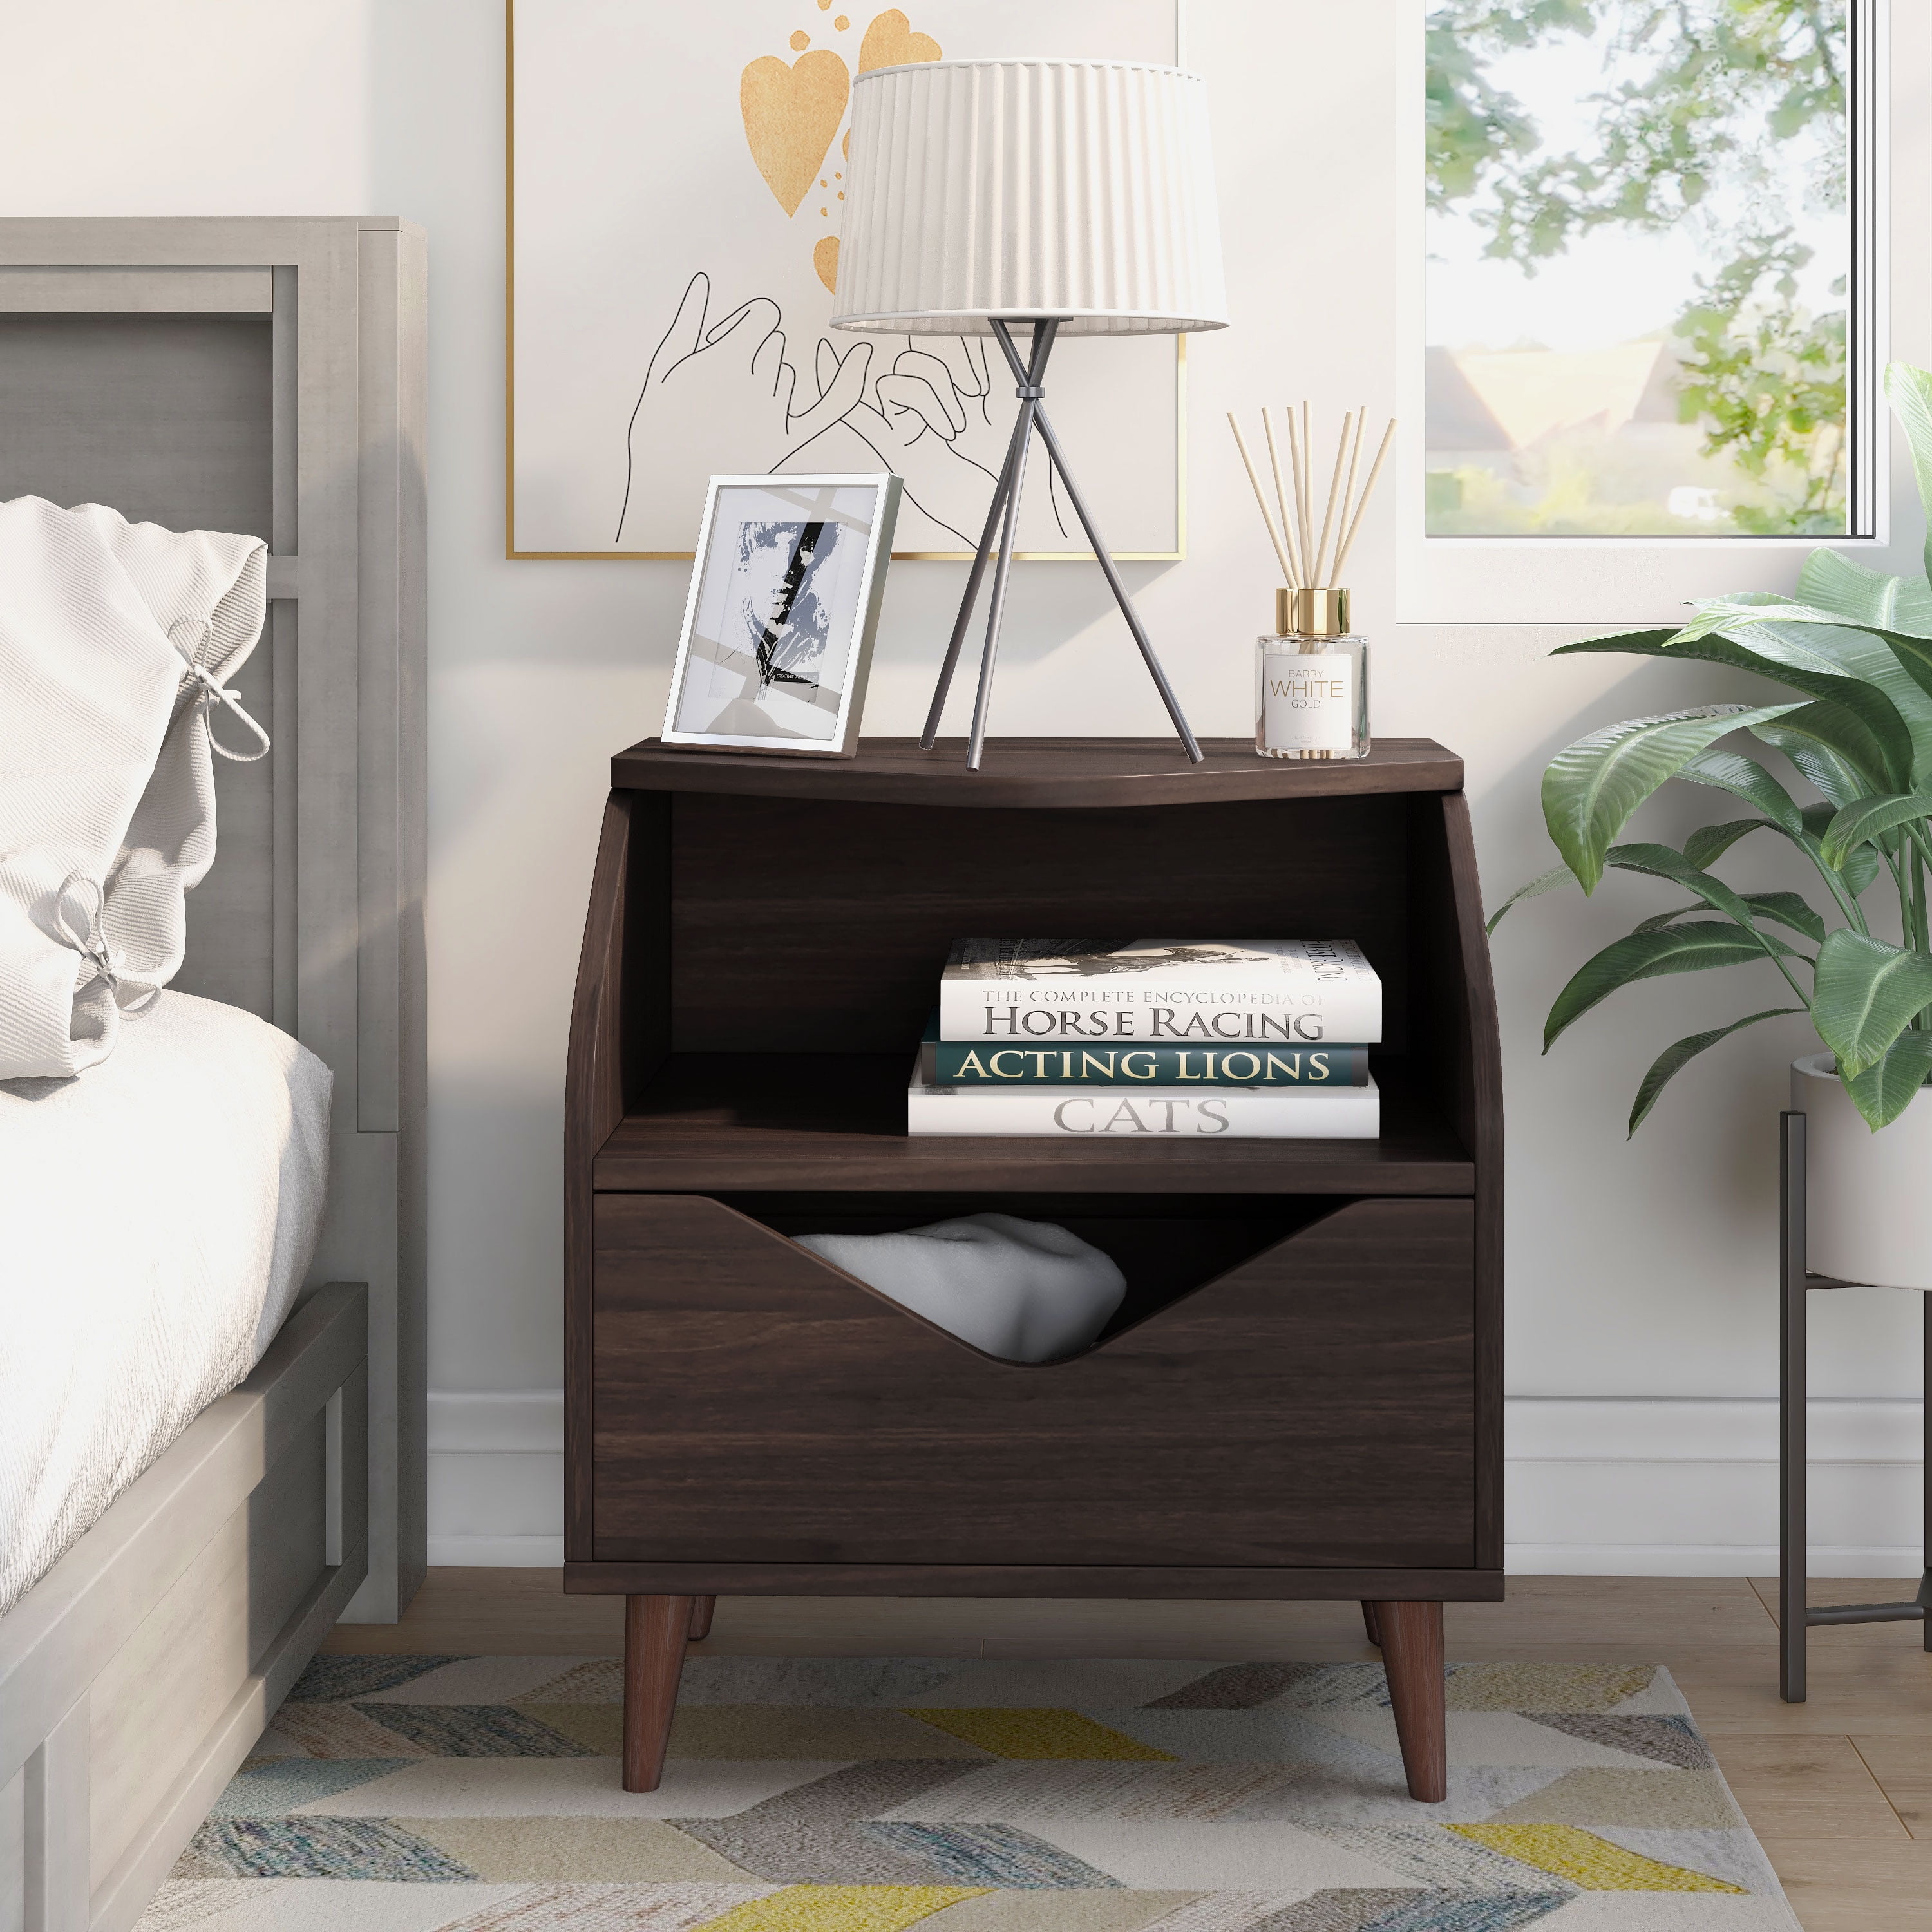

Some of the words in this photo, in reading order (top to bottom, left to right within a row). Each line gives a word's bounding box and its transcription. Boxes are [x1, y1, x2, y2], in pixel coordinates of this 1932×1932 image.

[1289, 670, 1324, 678] BARRY
[1270, 679, 1344, 697] WHITE
[1291, 699, 1321, 708] GOLD
[982, 990, 1022, 1002] THE
[1030, 990, 1135, 1003] COMPLETE
[1144, 992, 1294, 1005] ENCYCLOPEDIA
[982, 1007, 1135, 1036] HORSE
[1149, 1007, 1326, 1041] RACING
[953, 1050, 1159, 1079] ACTING
[1175, 1052, 1330, 1081] LIONS
[1054, 1097, 1229, 1133] CATS
